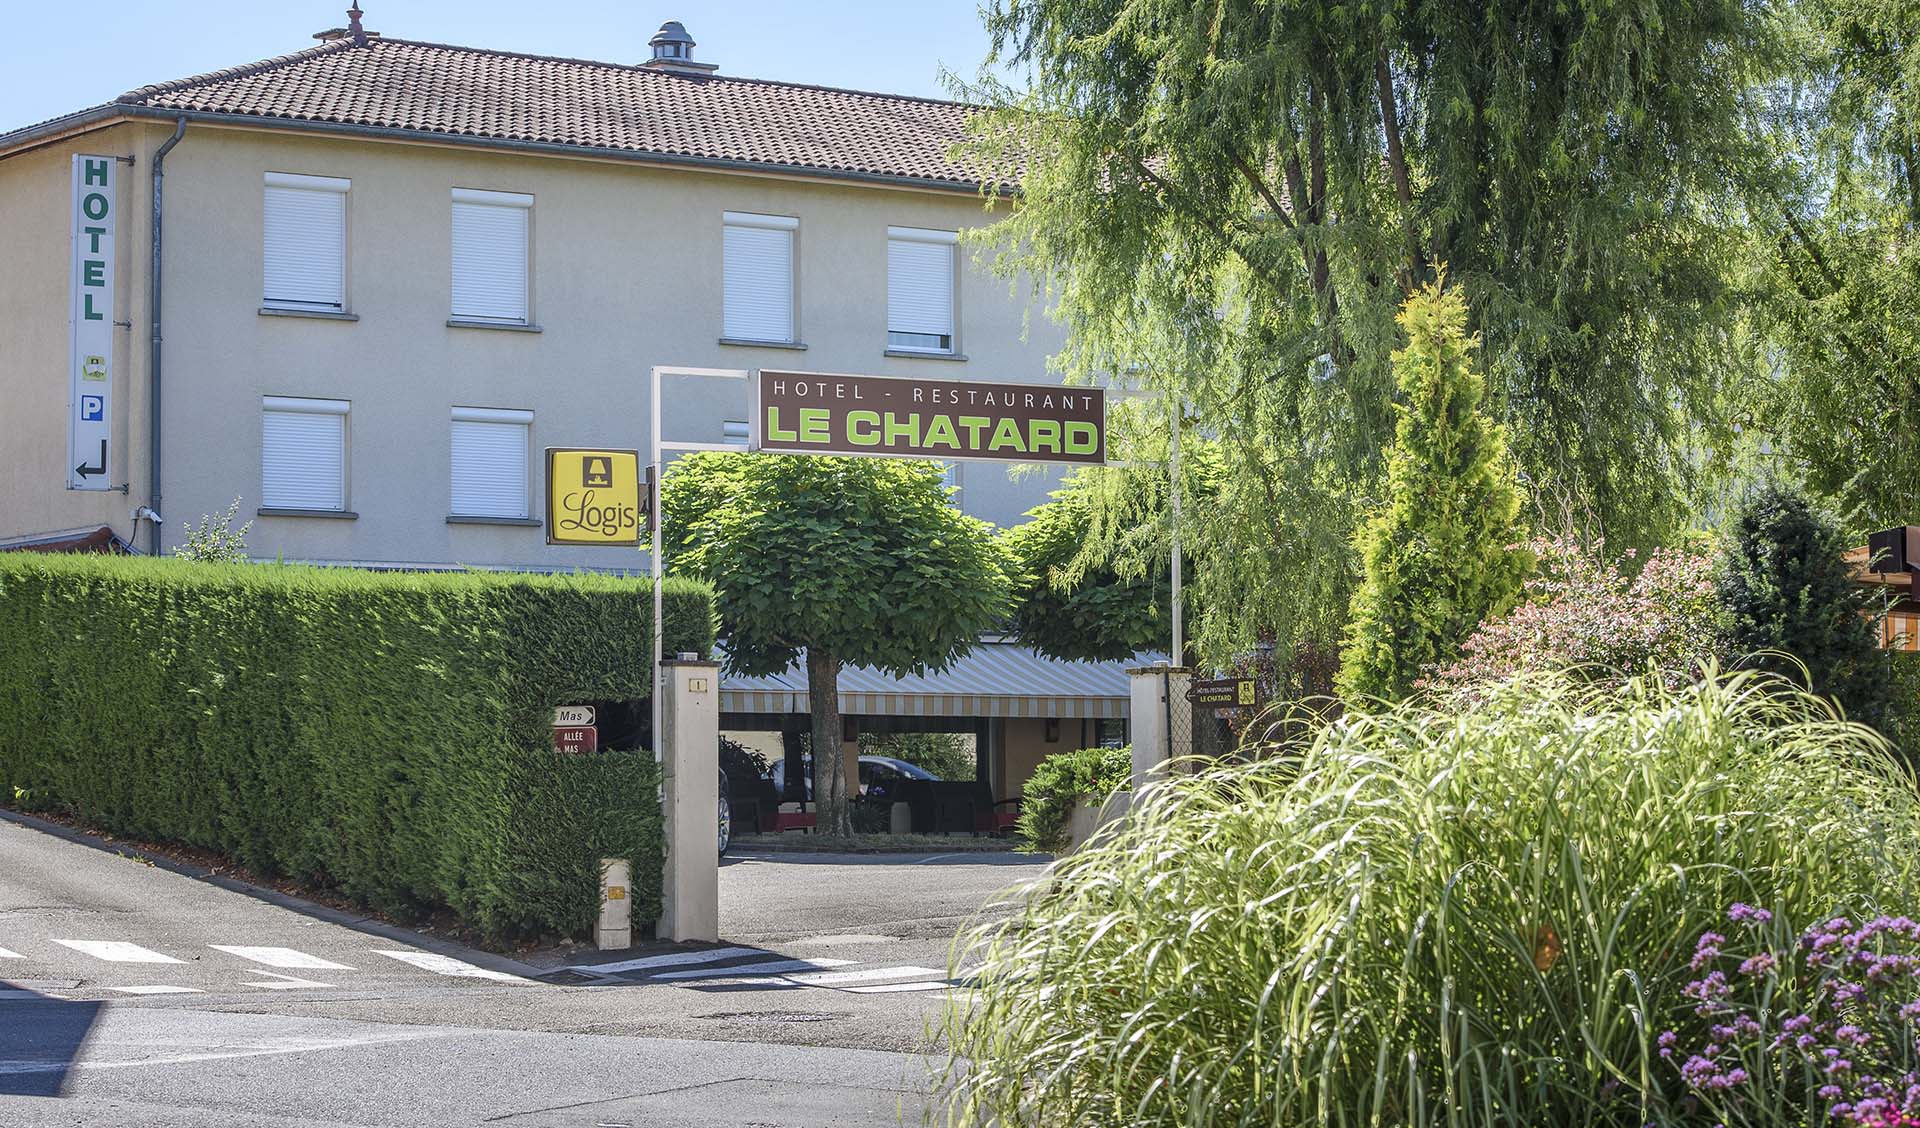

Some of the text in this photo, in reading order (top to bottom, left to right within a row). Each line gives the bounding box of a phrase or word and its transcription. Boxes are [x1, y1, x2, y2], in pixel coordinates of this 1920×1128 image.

[83, 159, 109, 321] HOTEL
[774, 381, 863, 400] HOTEL
[913, 387, 1093, 410] RESTAURANT
[83, 397, 102, 418] P
[768, 406, 1098, 455] LE CHATARD
[560, 490, 635, 536] Logis
[1207, 694, 1232, 702] CHATARD
[560, 711, 582, 721] Mas
[564, 731, 583, 741] ALLÉE
[564, 744, 579, 753] MAS
